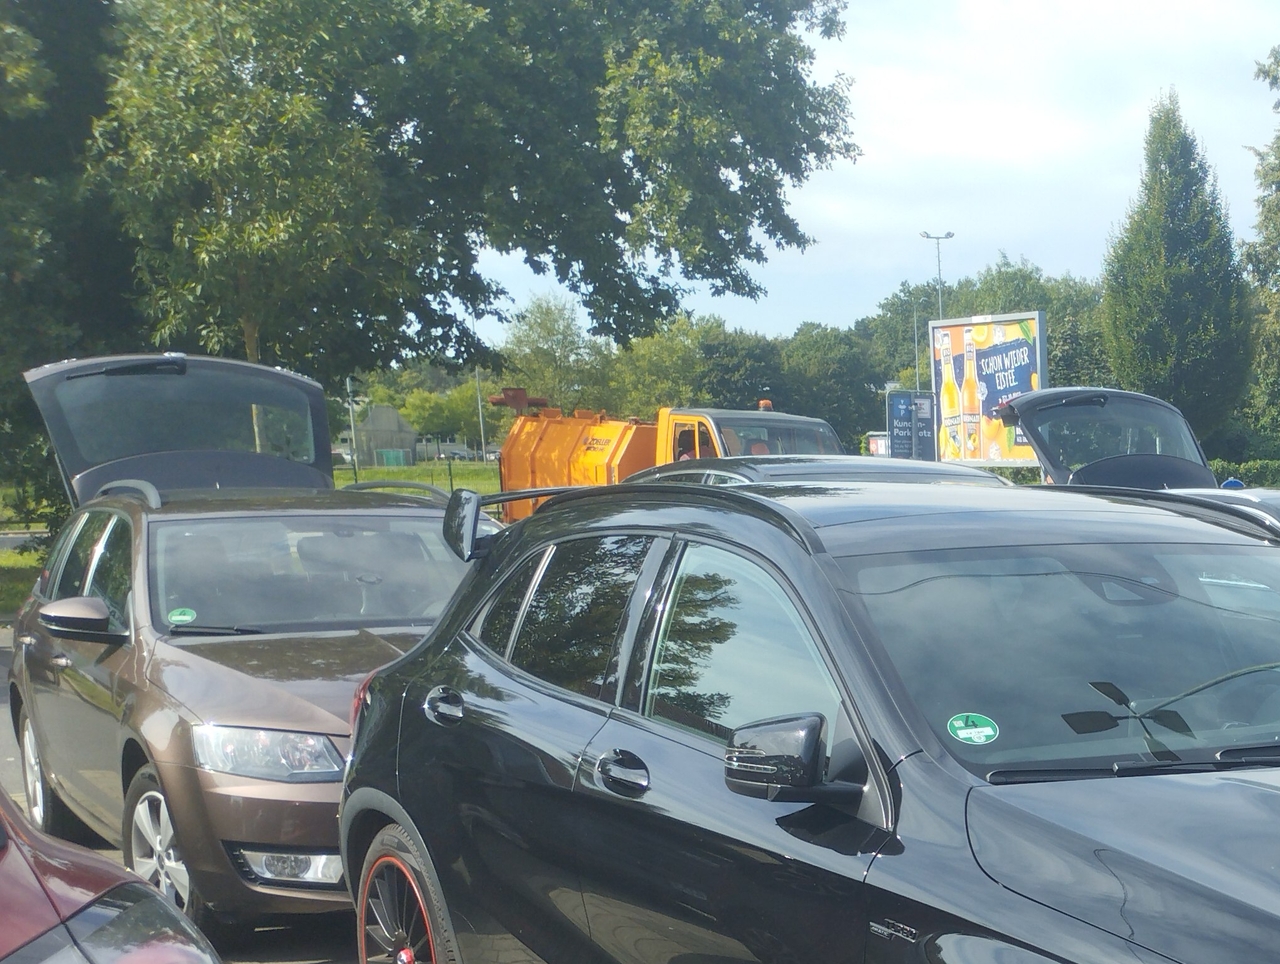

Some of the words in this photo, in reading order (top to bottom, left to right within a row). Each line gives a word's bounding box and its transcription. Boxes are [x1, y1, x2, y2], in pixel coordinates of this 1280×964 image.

[981, 354, 1003, 375] SCHON
[1003, 346, 1029, 371] WIEDER
[965, 715, 978, 728] 4
